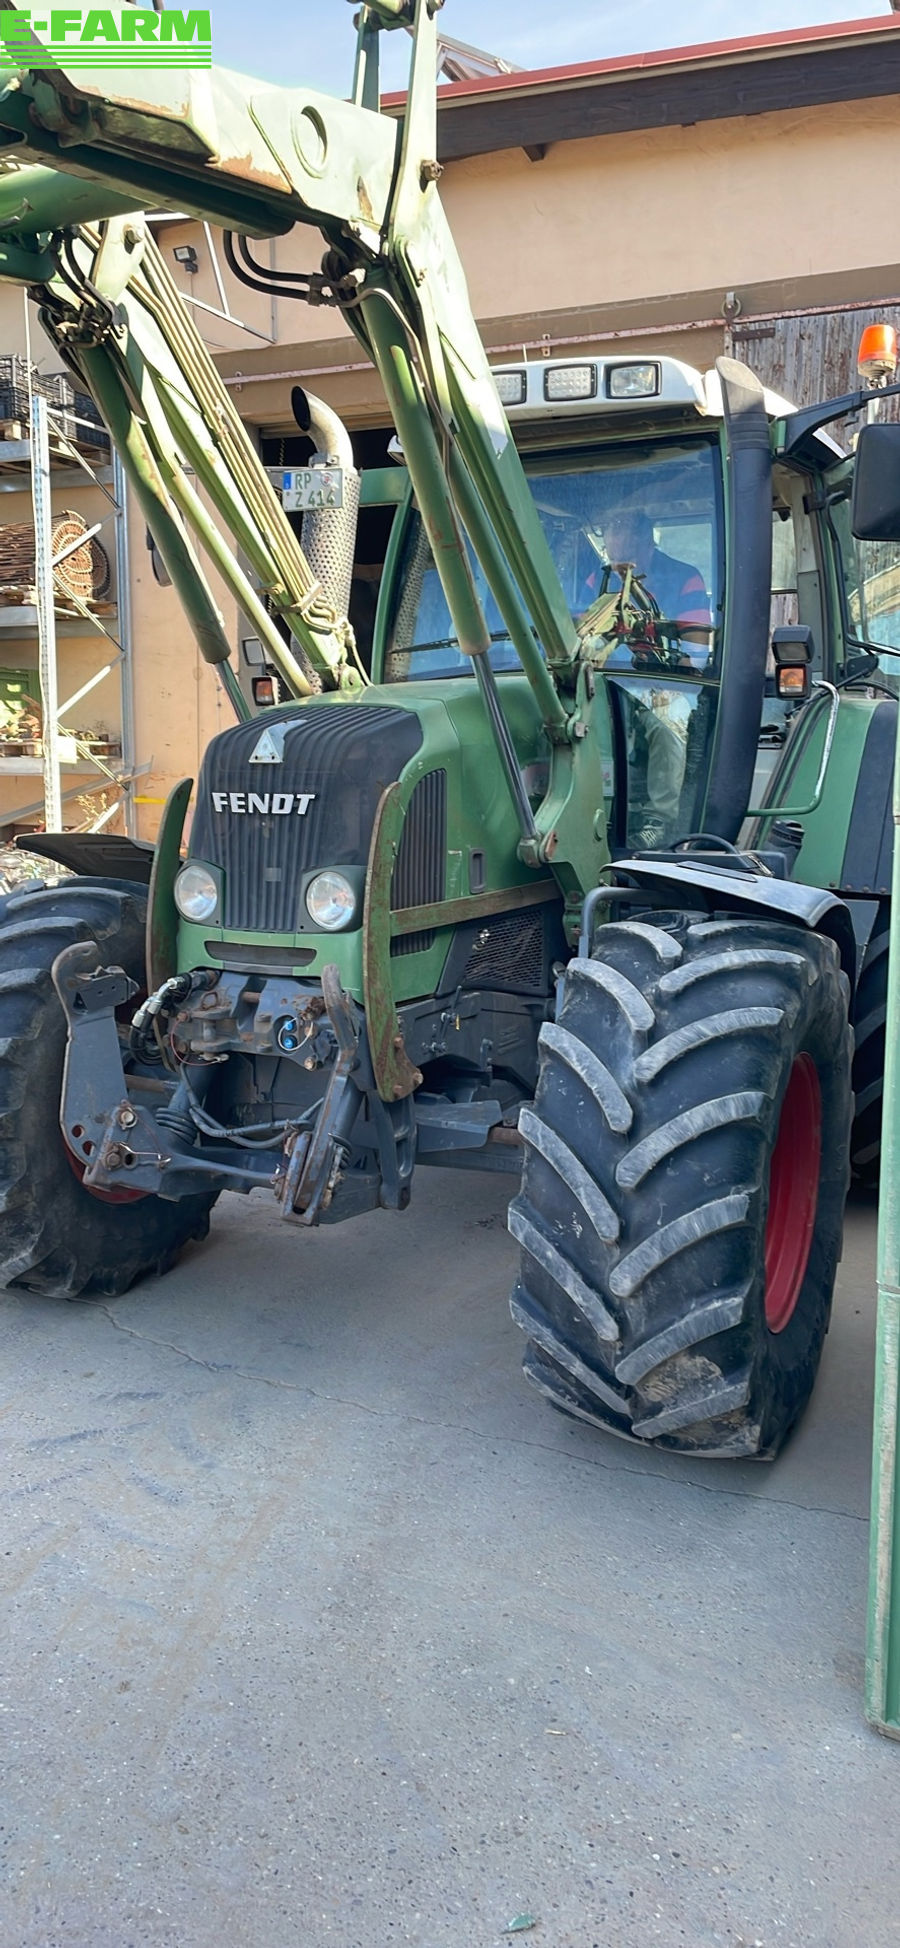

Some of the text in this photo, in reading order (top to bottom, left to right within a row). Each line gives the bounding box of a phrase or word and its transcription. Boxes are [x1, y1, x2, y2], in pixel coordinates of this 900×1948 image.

[294, 472, 312, 490] RP
[294, 489, 335, 508] Z 414
[212, 792, 316, 815] FENDT
